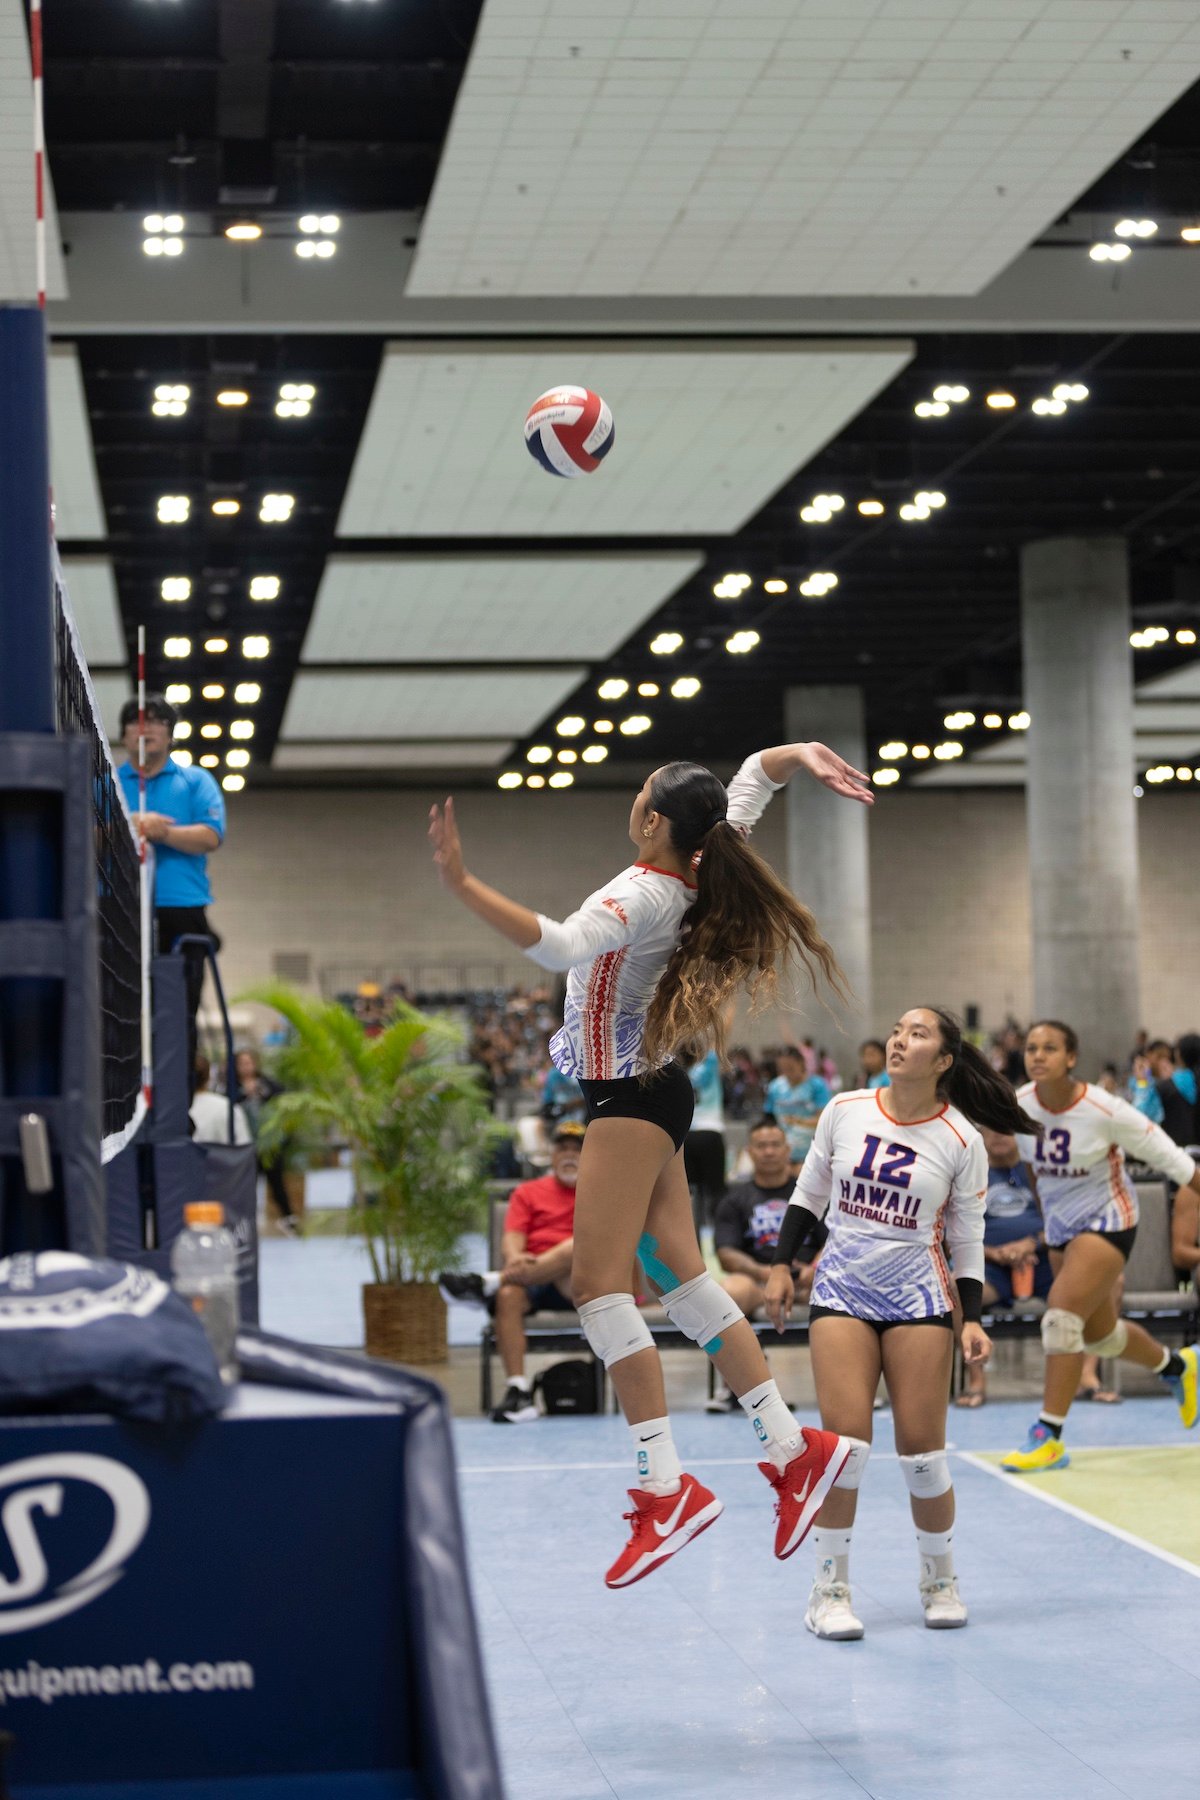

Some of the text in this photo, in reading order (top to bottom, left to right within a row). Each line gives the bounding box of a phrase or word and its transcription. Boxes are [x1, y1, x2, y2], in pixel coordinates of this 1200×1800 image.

[852, 1134, 917, 1190] 12
[1035, 1127, 1071, 1165] 13
[839, 1200, 917, 1230] VOLLEYBALL CLUB
[840, 1179, 921, 1217] HAWAII
